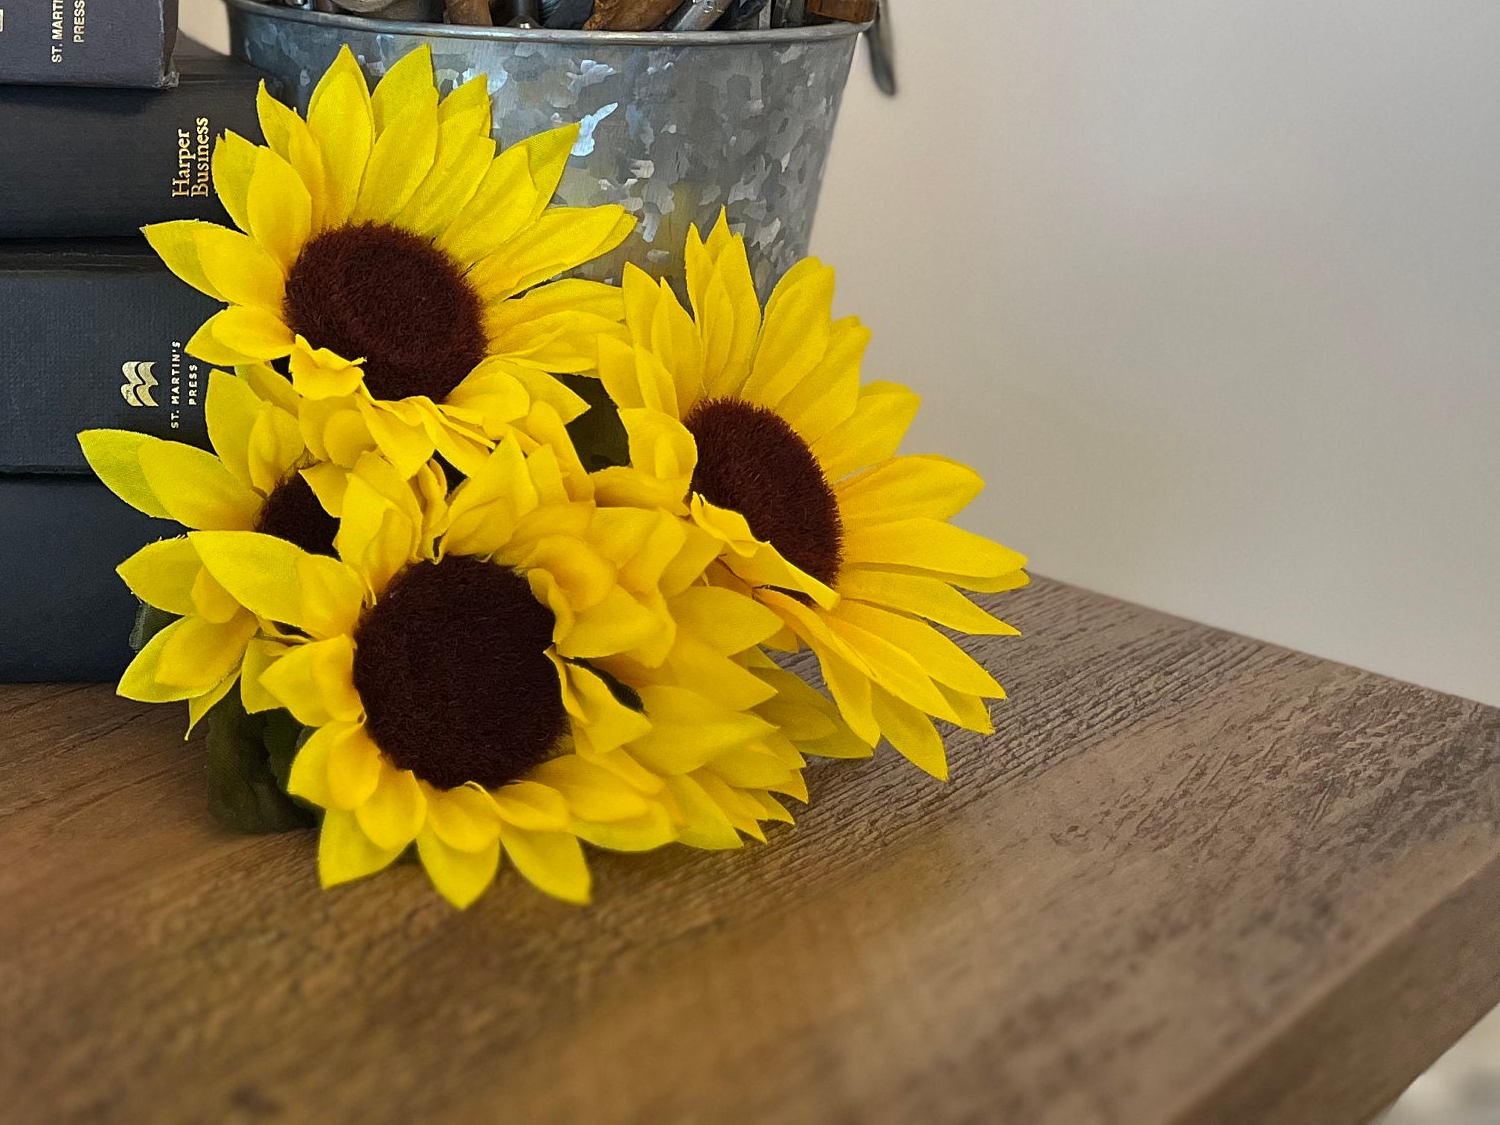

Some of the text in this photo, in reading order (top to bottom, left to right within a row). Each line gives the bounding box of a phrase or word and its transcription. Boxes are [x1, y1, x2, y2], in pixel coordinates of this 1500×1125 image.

[73, 0, 86, 43] PRESS
[51, 42, 63, 63] ST.
[171, 128, 197, 198] Harper
[190, 116, 211, 198] Business
[170, 341, 181, 429] ST. MARTIN'S
[188, 364, 198, 406] PRESS
